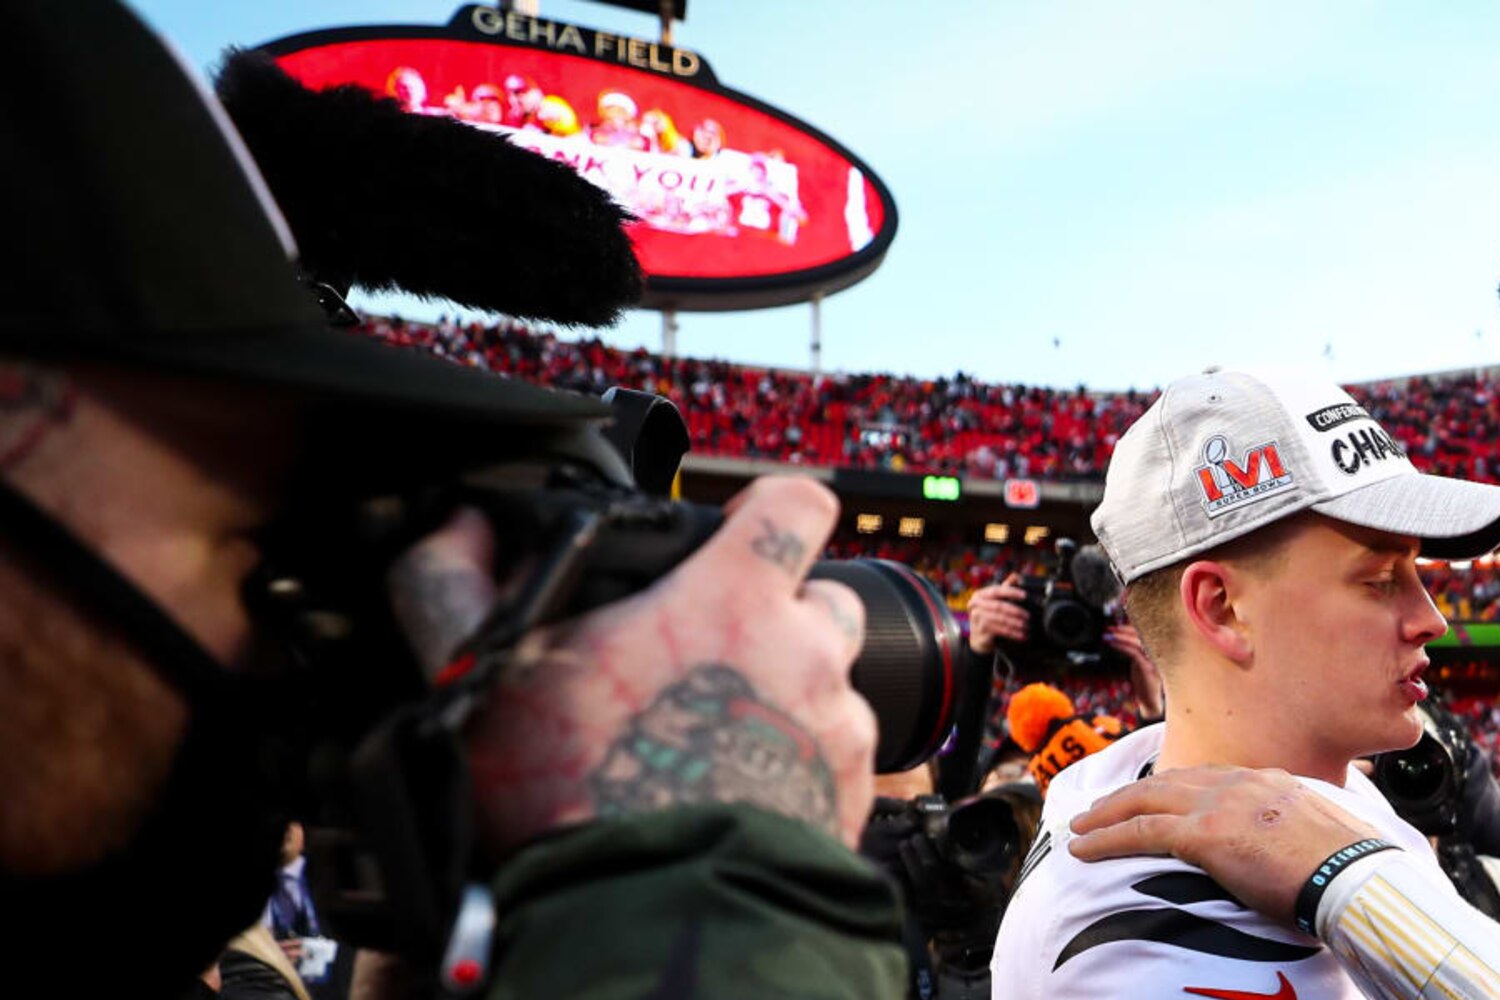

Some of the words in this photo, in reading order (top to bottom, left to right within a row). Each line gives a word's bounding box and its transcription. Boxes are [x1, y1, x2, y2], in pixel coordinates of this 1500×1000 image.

[472, 5, 588, 54] GEHA
[595, 31, 700, 77] FIELD
[632, 163, 716, 192] YOU
[1198, 444, 1286, 503] LVI
